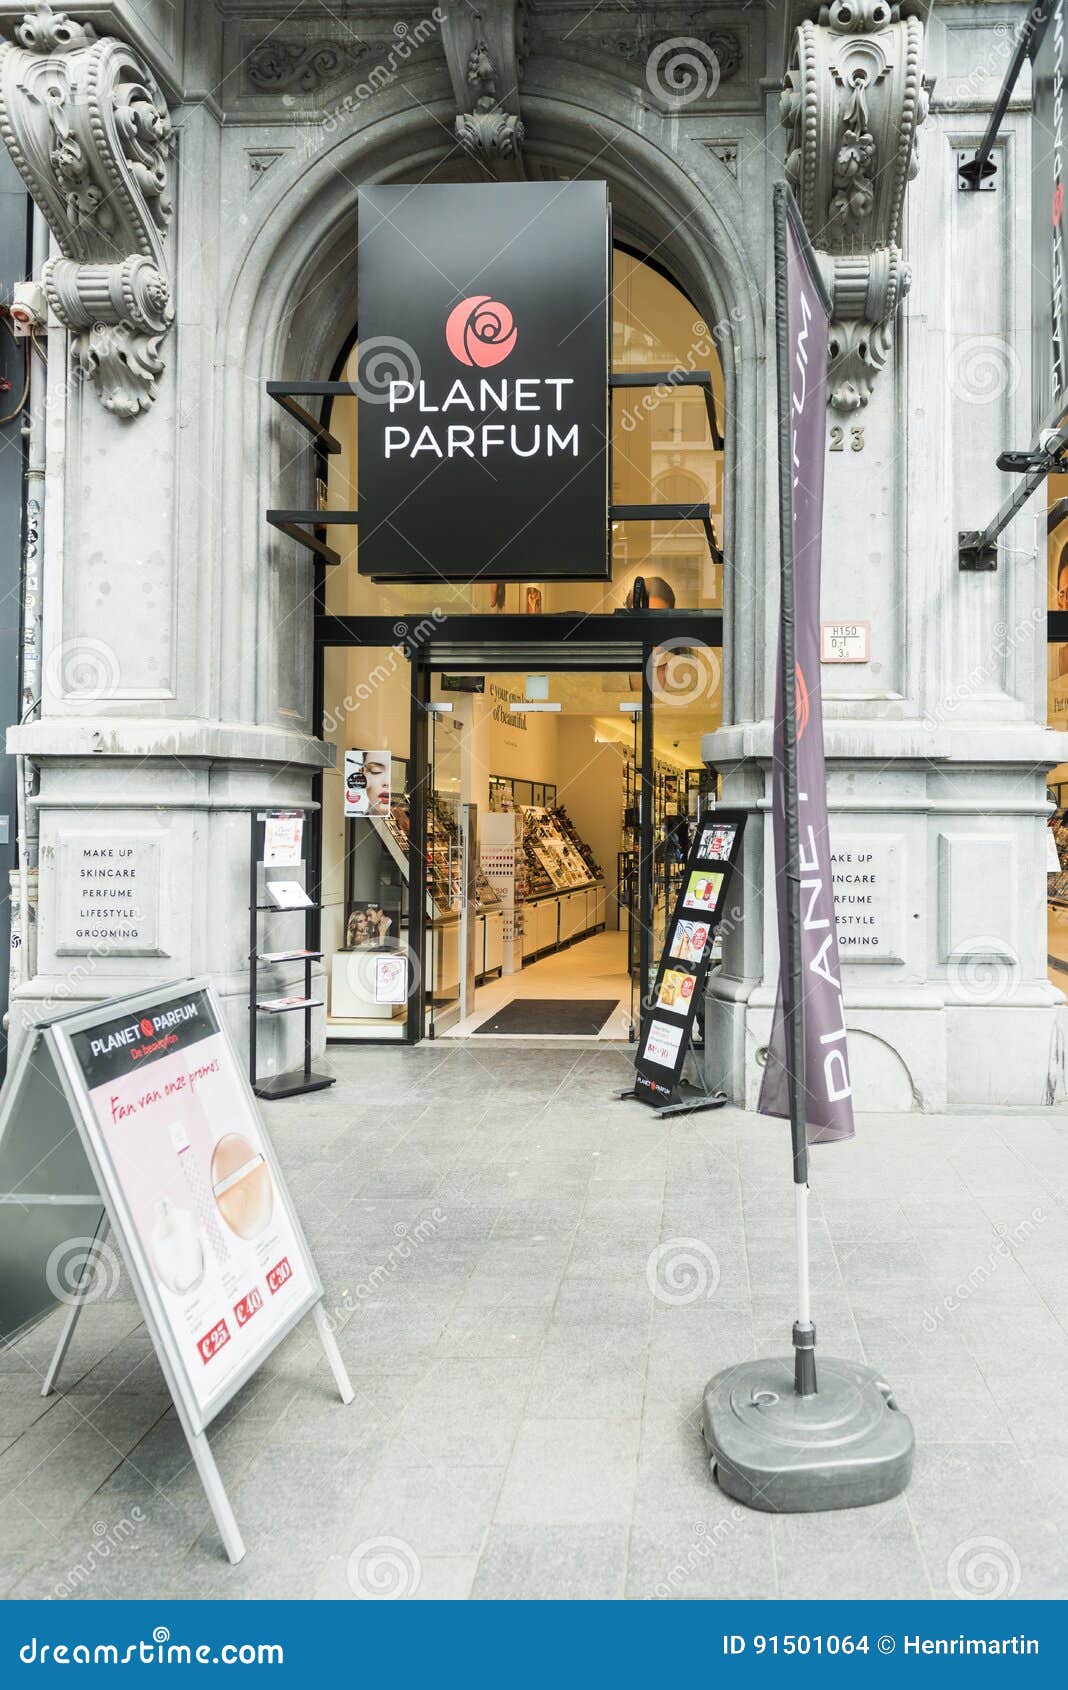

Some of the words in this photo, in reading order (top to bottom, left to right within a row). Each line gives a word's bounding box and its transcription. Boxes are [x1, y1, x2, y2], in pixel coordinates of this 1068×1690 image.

[1051, 237, 1064, 400] PLANET
[388, 378, 575, 413] PLANET
[384, 424, 579, 458] PARFUM
[829, 426, 864, 452] 23
[832, 626, 857, 636] H150
[83, 849, 113, 857] MAKE
[119, 849, 133, 857] UP
[831, 854, 852, 863] AKE
[858, 854, 873, 863] UP
[80, 869, 136, 877] SKINCARE
[832, 874, 876, 883] INCARE
[82, 889, 133, 898] PERFUME
[833, 895, 872, 904] RFUME
[80, 909, 135, 918] LIFESTYLE
[835, 916, 876, 924] ESTYLE
[75, 929, 138, 938] GROOMING
[838, 936, 879, 945] OMING
[798, 792, 852, 1103] PLANE
[90, 1024, 142, 1057] PLANET
[152, 1002, 199, 1032] PARFUM
[110, 1096, 137, 1125] Fan
[138, 1089, 162, 1108] van
[164, 1075, 187, 1096] onze
